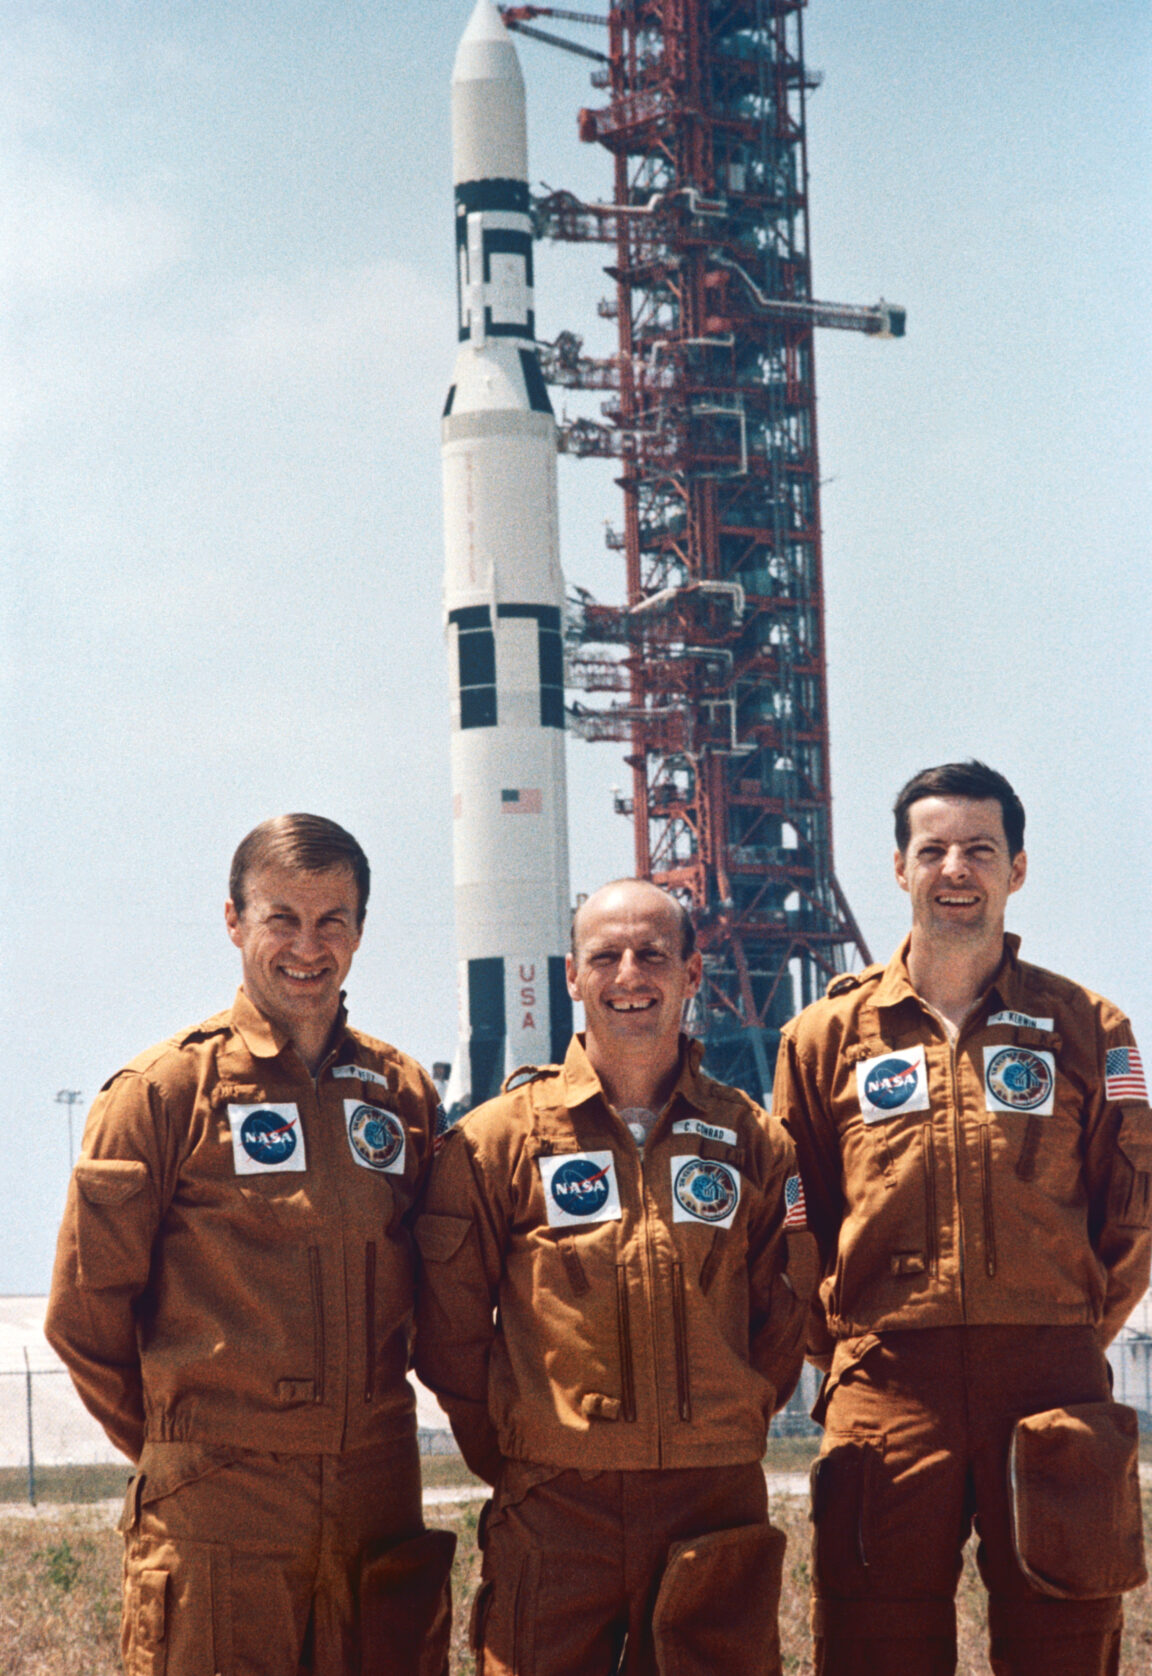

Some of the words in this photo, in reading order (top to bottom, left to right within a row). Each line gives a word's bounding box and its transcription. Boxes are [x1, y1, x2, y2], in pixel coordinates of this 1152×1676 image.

[519, 964, 537, 1030] USA
[867, 1073, 916, 1094] NASA
[245, 1131, 293, 1144] NASA
[695, 1122, 725, 1140] CONRAD
[555, 1179, 605, 1196] NASA
